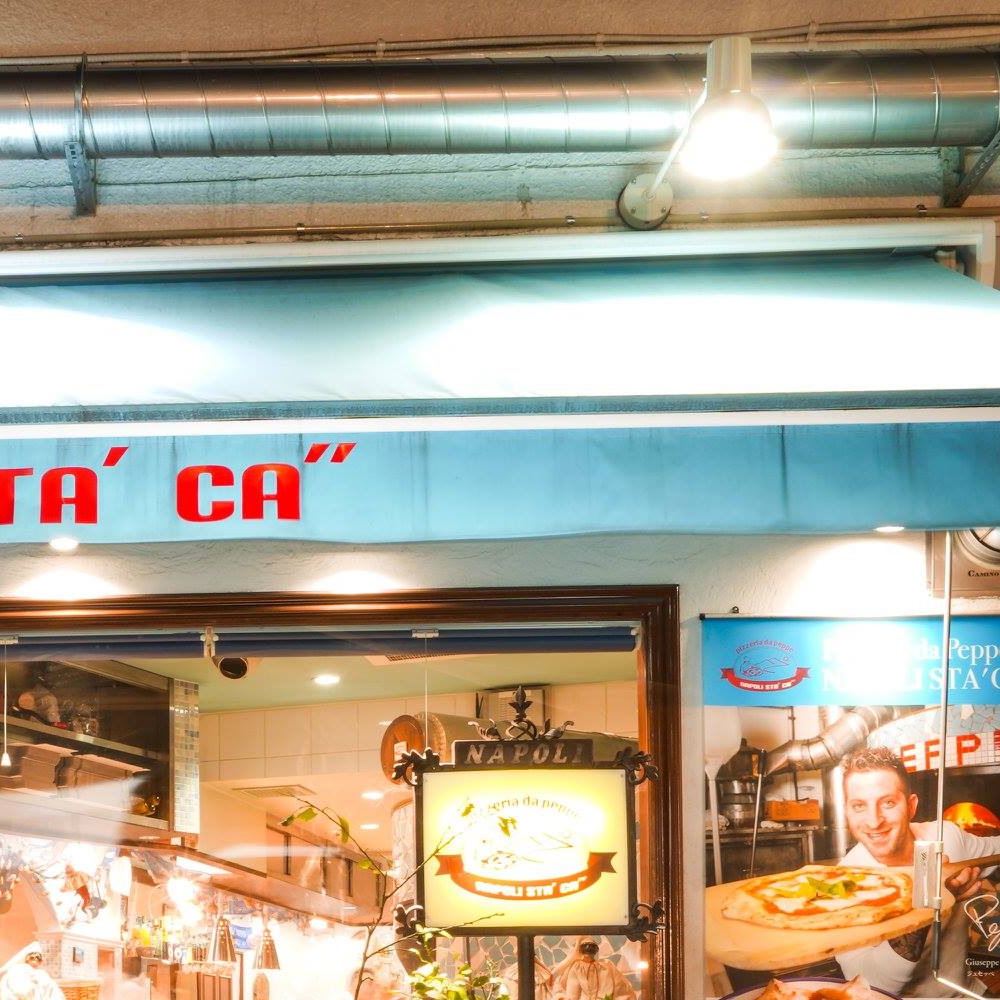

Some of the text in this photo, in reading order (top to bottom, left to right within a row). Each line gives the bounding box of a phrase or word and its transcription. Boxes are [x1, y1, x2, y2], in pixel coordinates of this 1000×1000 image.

[948, 638, 1000, 665] Pepp
[464, 743, 583, 764] NAPOLI
[965, 958, 999, 968] Giuseppe
